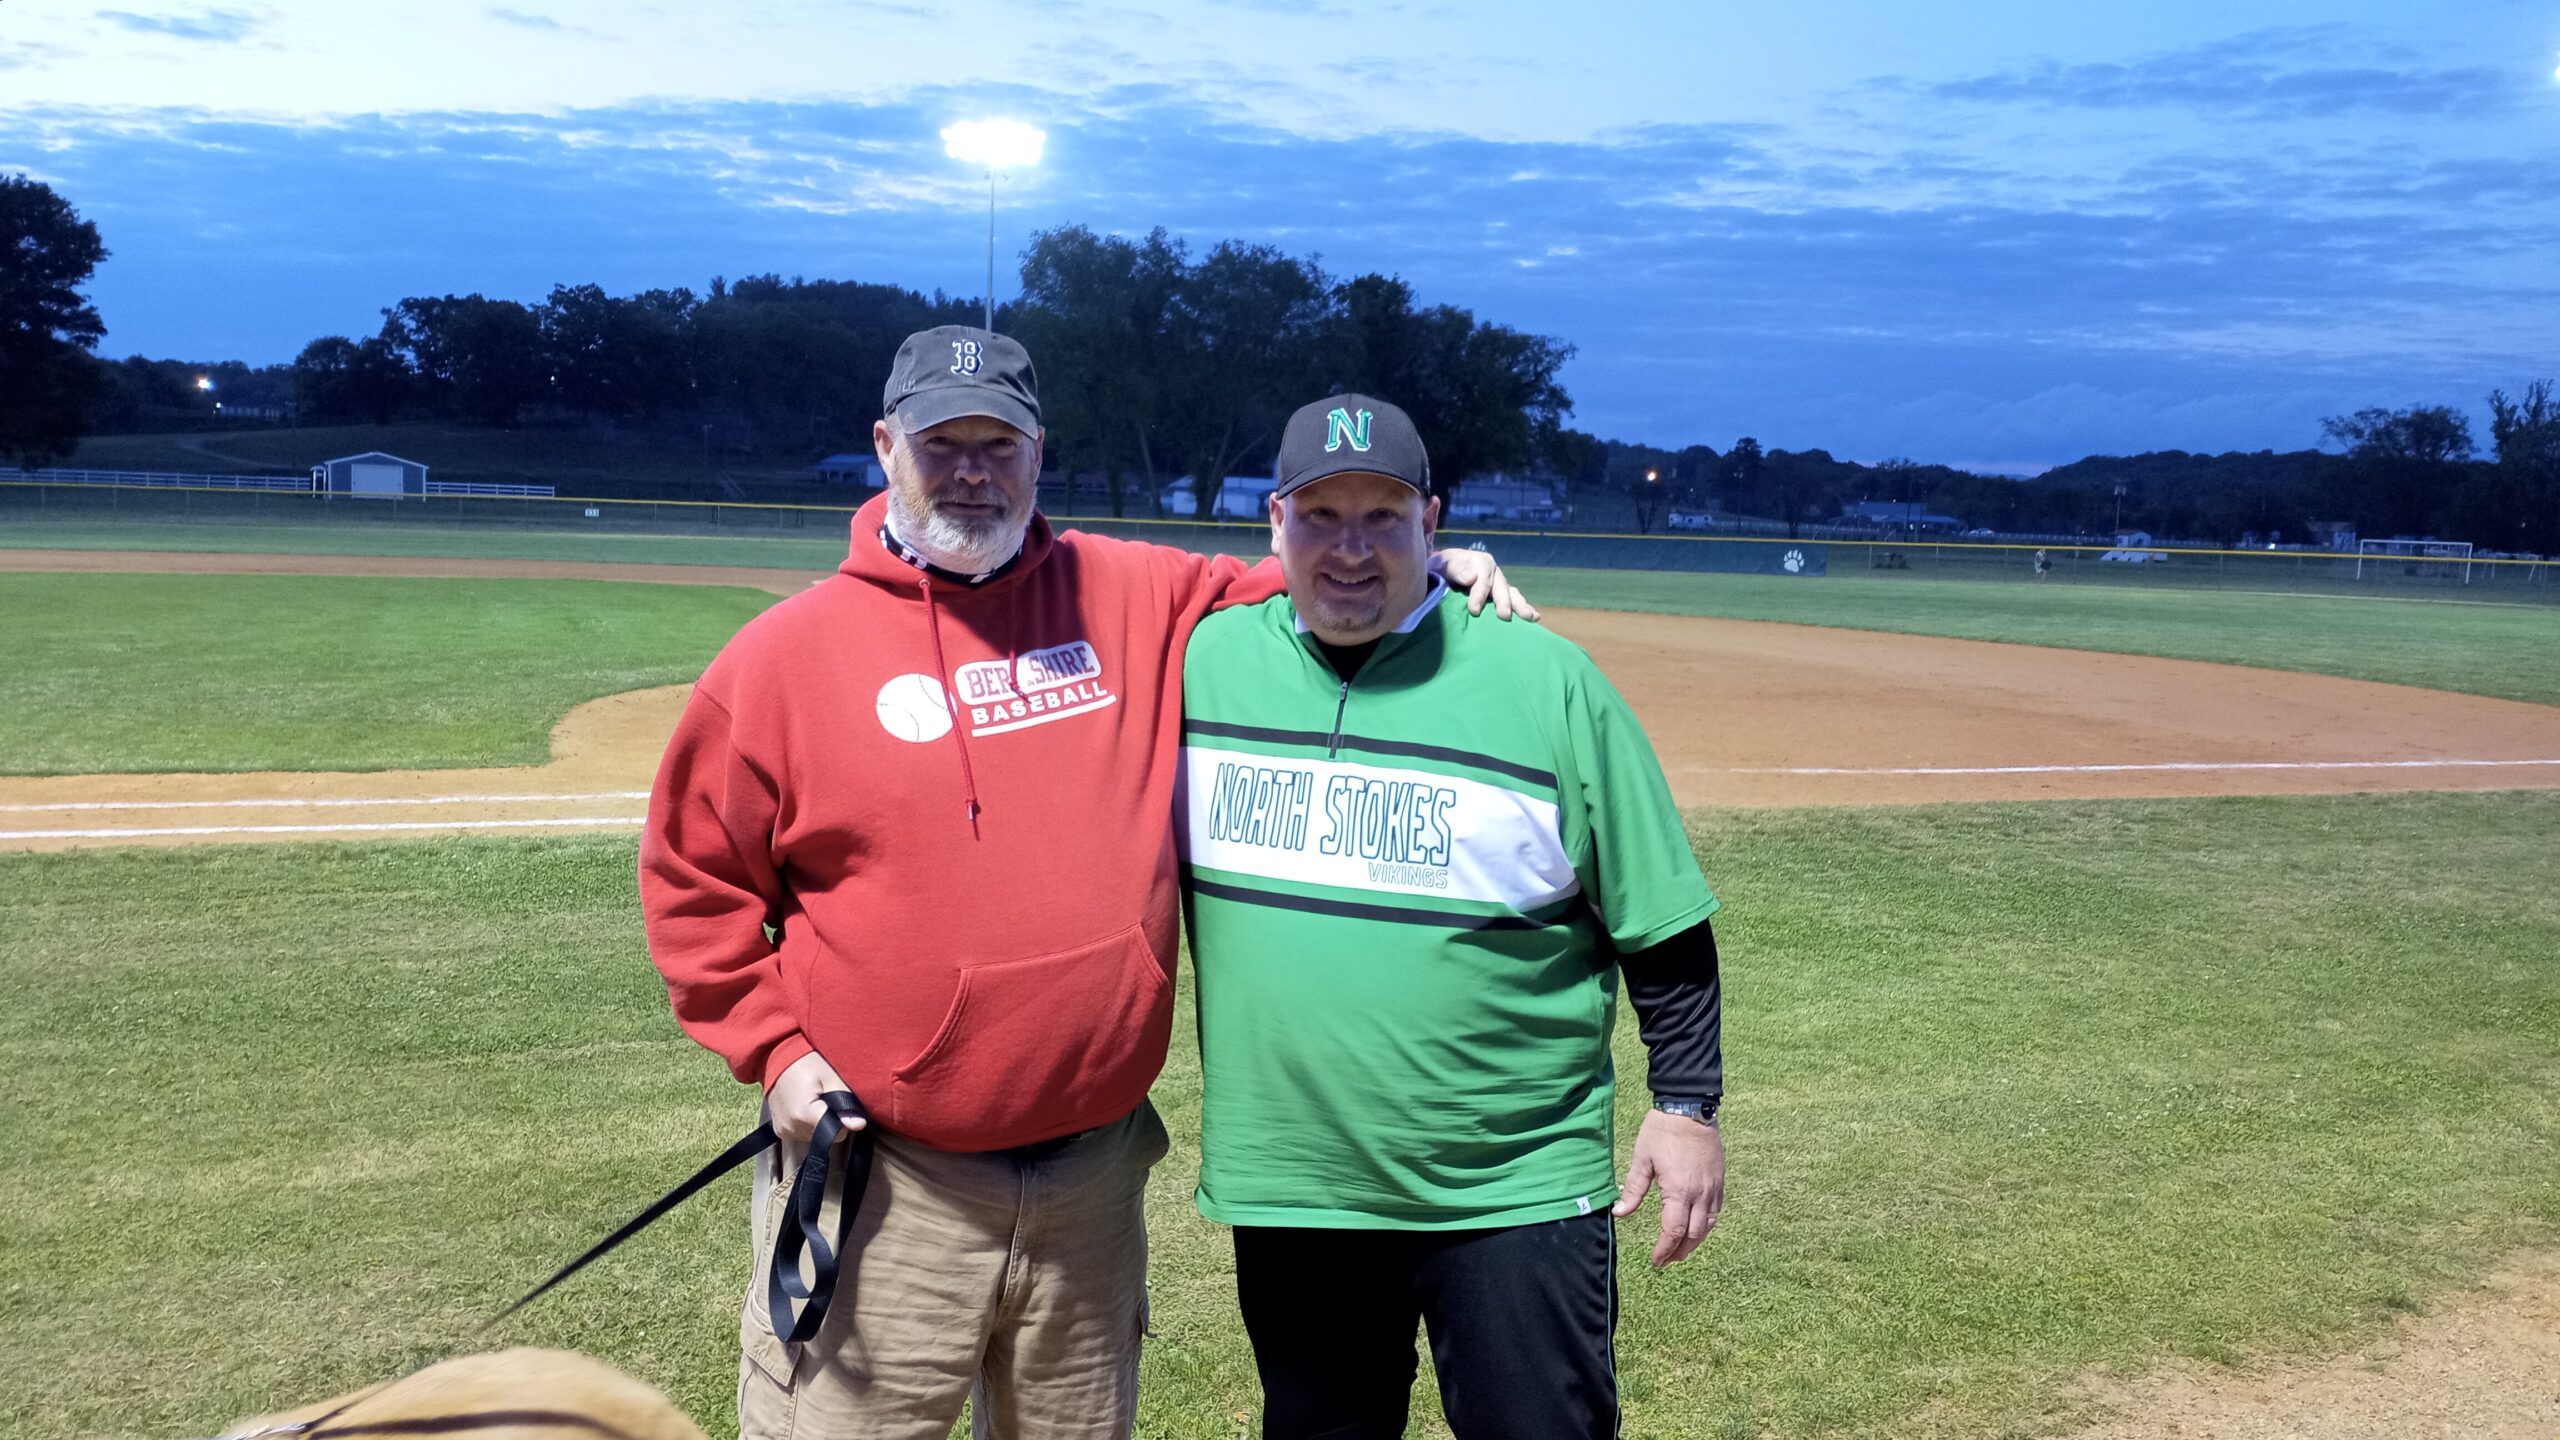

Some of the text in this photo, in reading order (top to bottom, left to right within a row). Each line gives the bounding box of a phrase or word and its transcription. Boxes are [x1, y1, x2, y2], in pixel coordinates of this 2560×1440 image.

[950, 339, 983, 376] B
[1325, 407, 1373, 452] N
[964, 646, 1095, 699] BERSHIRE
[971, 681, 1108, 725] BASEBALL
[1209, 763, 1456, 867] NORTH STOKES
[1368, 862, 1448, 889] VIKINGS
